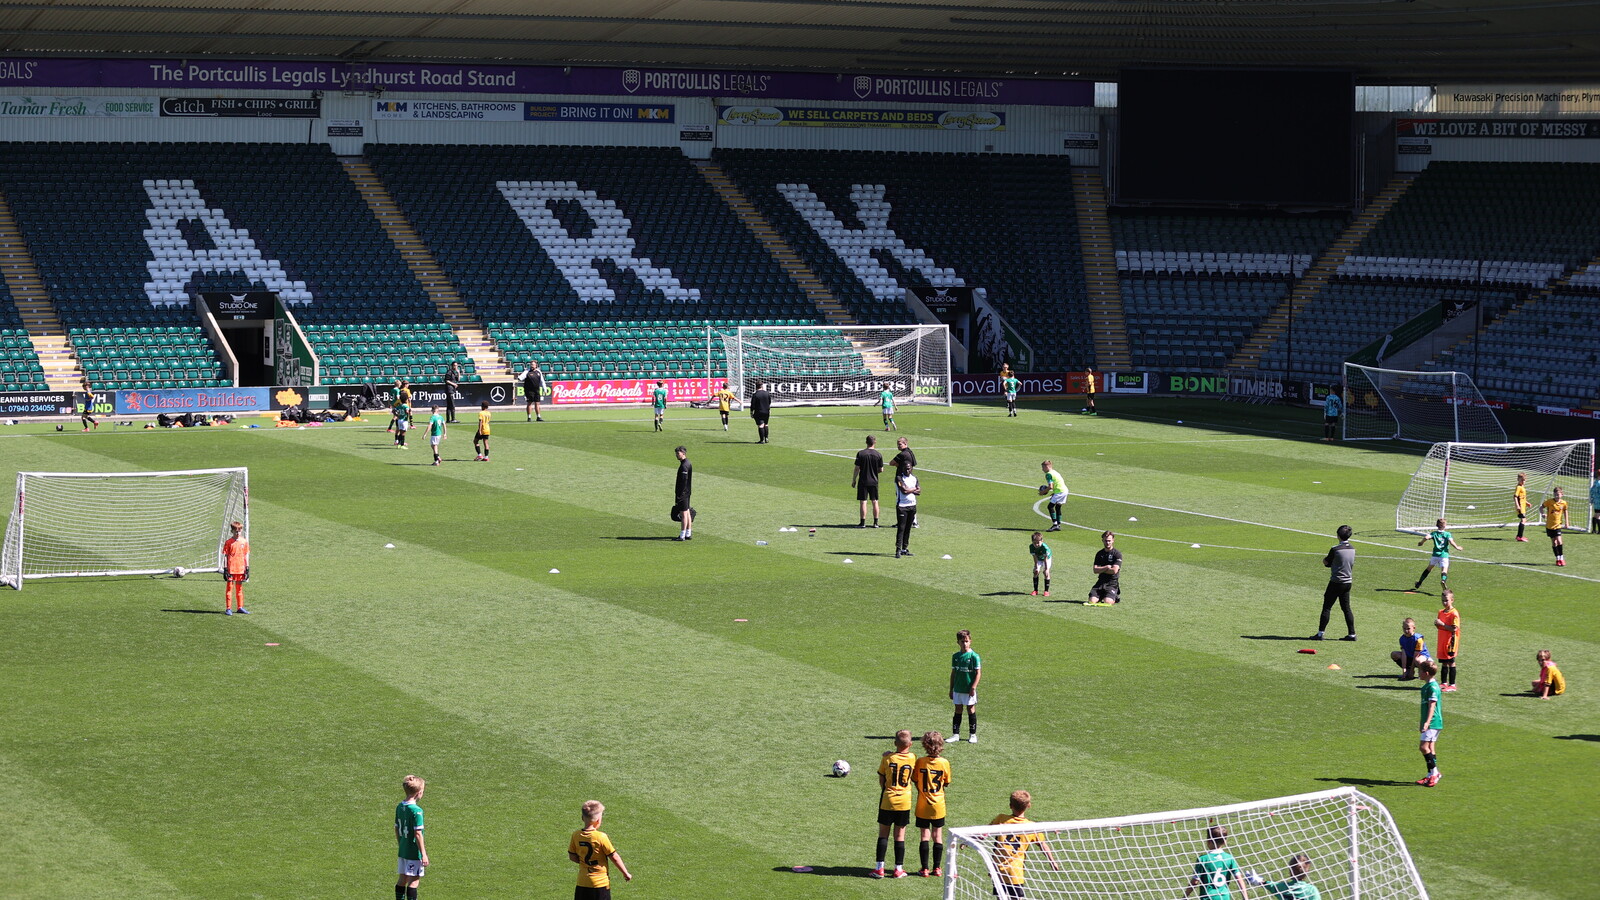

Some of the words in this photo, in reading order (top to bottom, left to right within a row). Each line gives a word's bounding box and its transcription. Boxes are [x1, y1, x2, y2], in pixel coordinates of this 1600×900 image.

[150, 65, 183, 81] The
[189, 65, 267, 83] Portcullis
[272, 67, 326, 87] Legals
[331, 67, 415, 88] Lyndhurst
[421, 69, 463, 86] Road
[468, 70, 516, 86] Stand
[644, 73, 721, 90] PORTCULLIS
[875, 78, 950, 96] PORTCULLIS
[1453, 93, 1493, 102] Kawasaki
[1495, 93, 1534, 102] Precision
[1, 101, 47, 115] Tamar
[49, 102, 87, 115] Fresh
[105, 102, 124, 113] FOOD
[125, 102, 154, 113] SERVICE
[211, 100, 235, 109] FISH
[245, 100, 276, 109] CHIPS
[285, 101, 318, 110] GRILL
[377, 102, 408, 112] MKM
[413, 102, 458, 111] KITCHENS,
[461, 103, 517, 112] BATHROOMS
[421, 111, 484, 119] LANDSCAPING
[560, 106, 597, 118] BRING
[600, 107, 610, 119] IT
[613, 107, 633, 119] ON!
[638, 108, 669, 119] MKM
[788, 109, 804, 119] WE
[807, 110, 829, 120] SELL
[832, 110, 880, 121] CARPETS
[881, 112, 905, 122] AND
[906, 112, 934, 122] BEDS
[1413, 122, 1437, 135] WE
[1439, 122, 1477, 136] LOVE
[1479, 122, 1490, 136] A
[1492, 122, 1517, 136] BIT
[1520, 122, 1539, 136] OF
[1542, 122, 1587, 137] MESSY
[920, 377, 939, 386] WH
[1118, 375, 1142, 383] BOND
[672, 388, 696, 396] SURF
[915, 385, 944, 395] BOND
[1170, 375, 1229, 393] BOND
[1231, 378, 1284, 399] TIMBER
[29, 395, 65, 403] SERVICES
[143, 393, 193, 408] Classic
[197, 392, 257, 408] Builders
[418, 391, 465, 403] Plymoth.
[8, 405, 30, 413] 07940
[30, 404, 56, 412] 234055
[77, 403, 113, 413] BND
[889, 763, 912, 787] 10
[920, 768, 943, 793] 13
[578, 841, 598, 866] 2
[1213, 867, 1227, 887] 6
